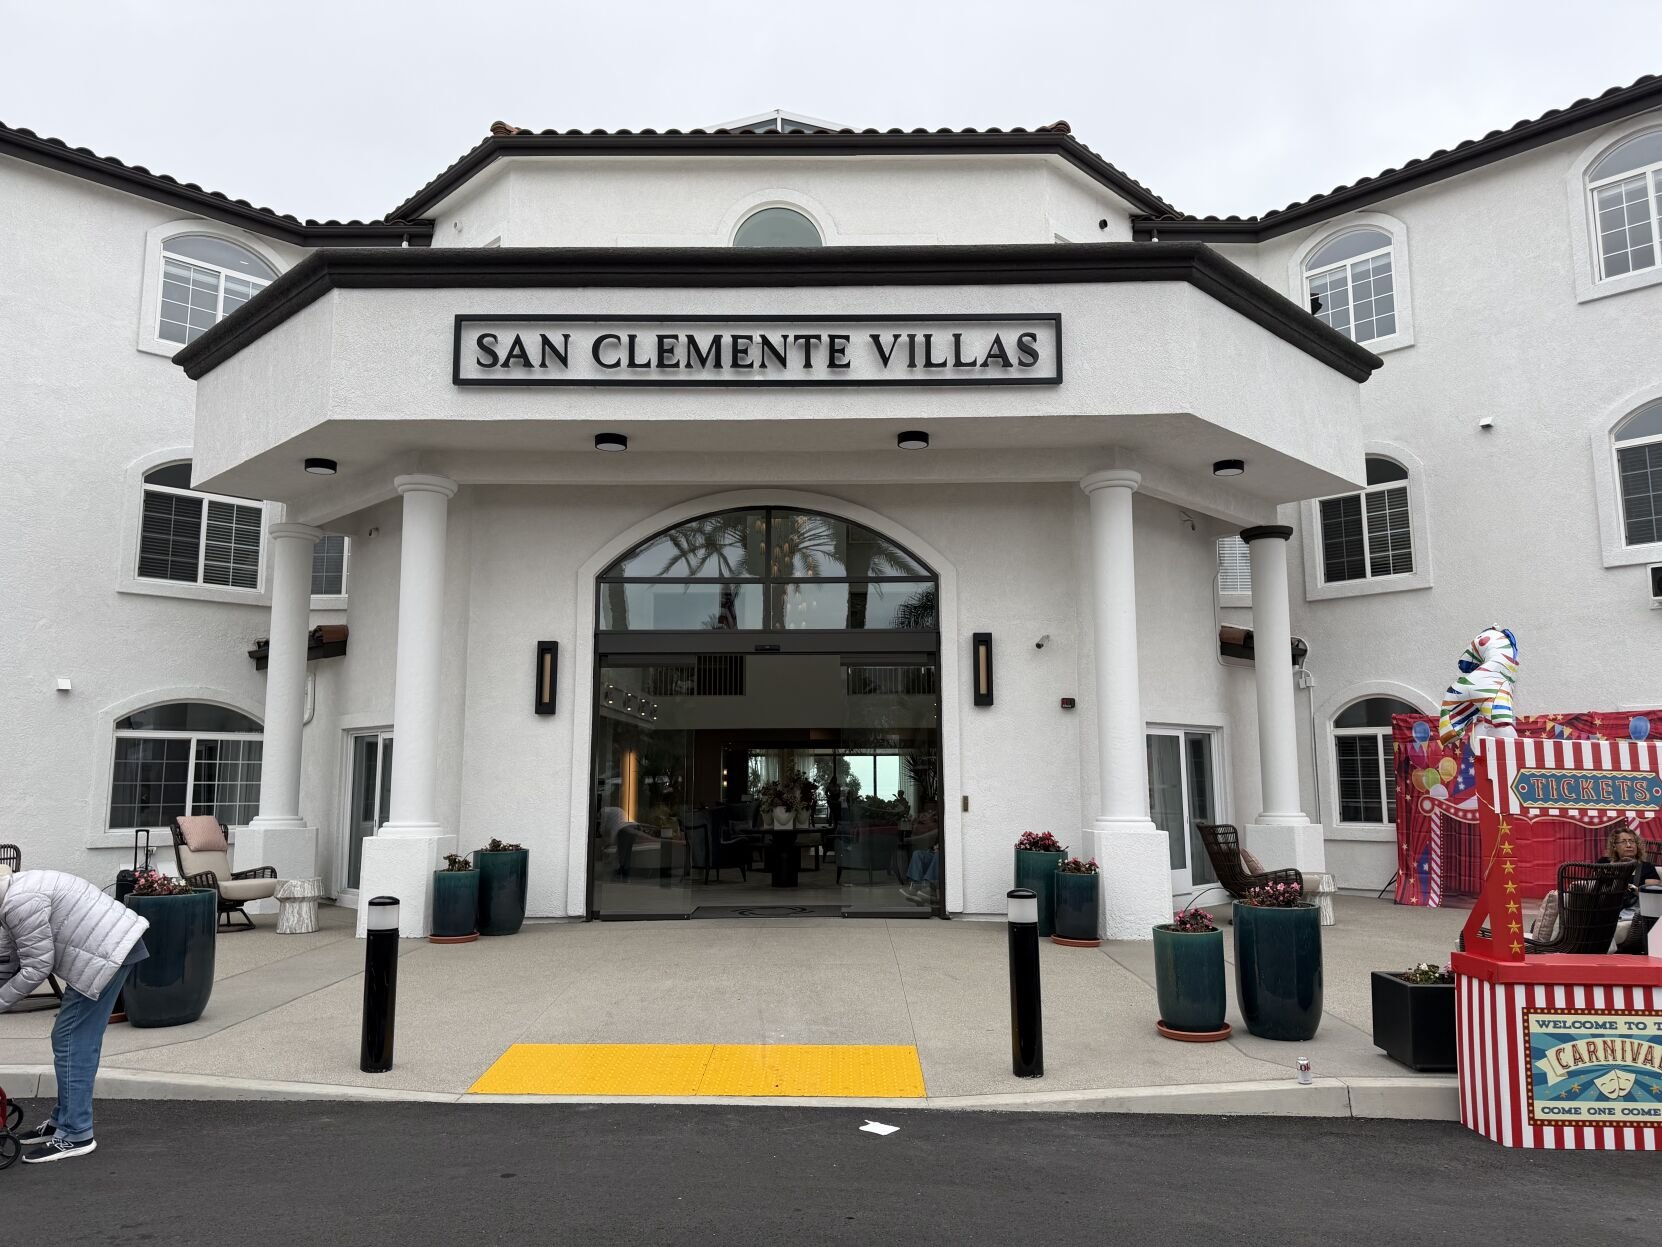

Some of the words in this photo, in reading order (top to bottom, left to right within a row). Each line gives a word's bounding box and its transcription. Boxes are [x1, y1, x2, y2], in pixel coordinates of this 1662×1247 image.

[476, 333, 571, 369] SAN
[592, 333, 850, 369] CLEMENTE
[869, 332, 1040, 368] VILLAS
[1531, 777, 1650, 801] TICKETS
[1535, 1019, 1618, 1030] WELCOME
[1624, 1021, 1647, 1030] TO
[1541, 1106, 1582, 1115] COME
[1587, 1107, 1616, 1116] ONE
[1621, 1107, 1662, 1116] COME
